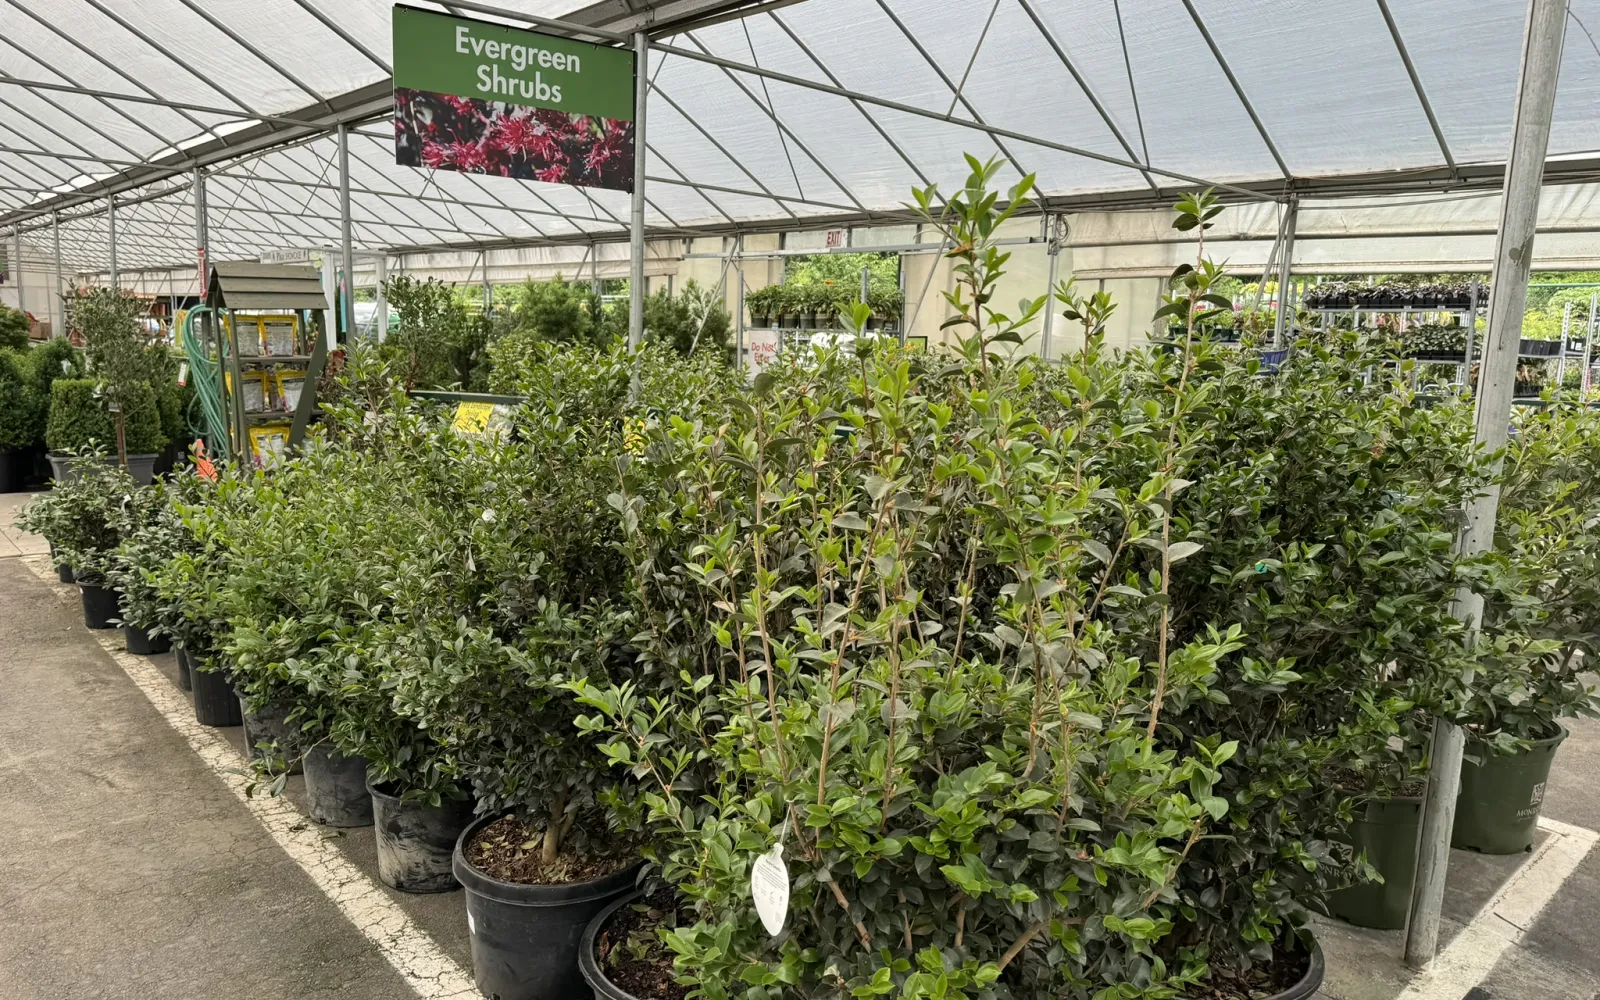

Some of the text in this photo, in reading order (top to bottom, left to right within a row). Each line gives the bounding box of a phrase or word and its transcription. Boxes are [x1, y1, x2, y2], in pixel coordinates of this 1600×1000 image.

[455, 26, 580, 73] Evergreen
[476, 65, 562, 102] Shrubs
[827, 231, 841, 245] EXIT
[751, 342, 760, 351] Do
